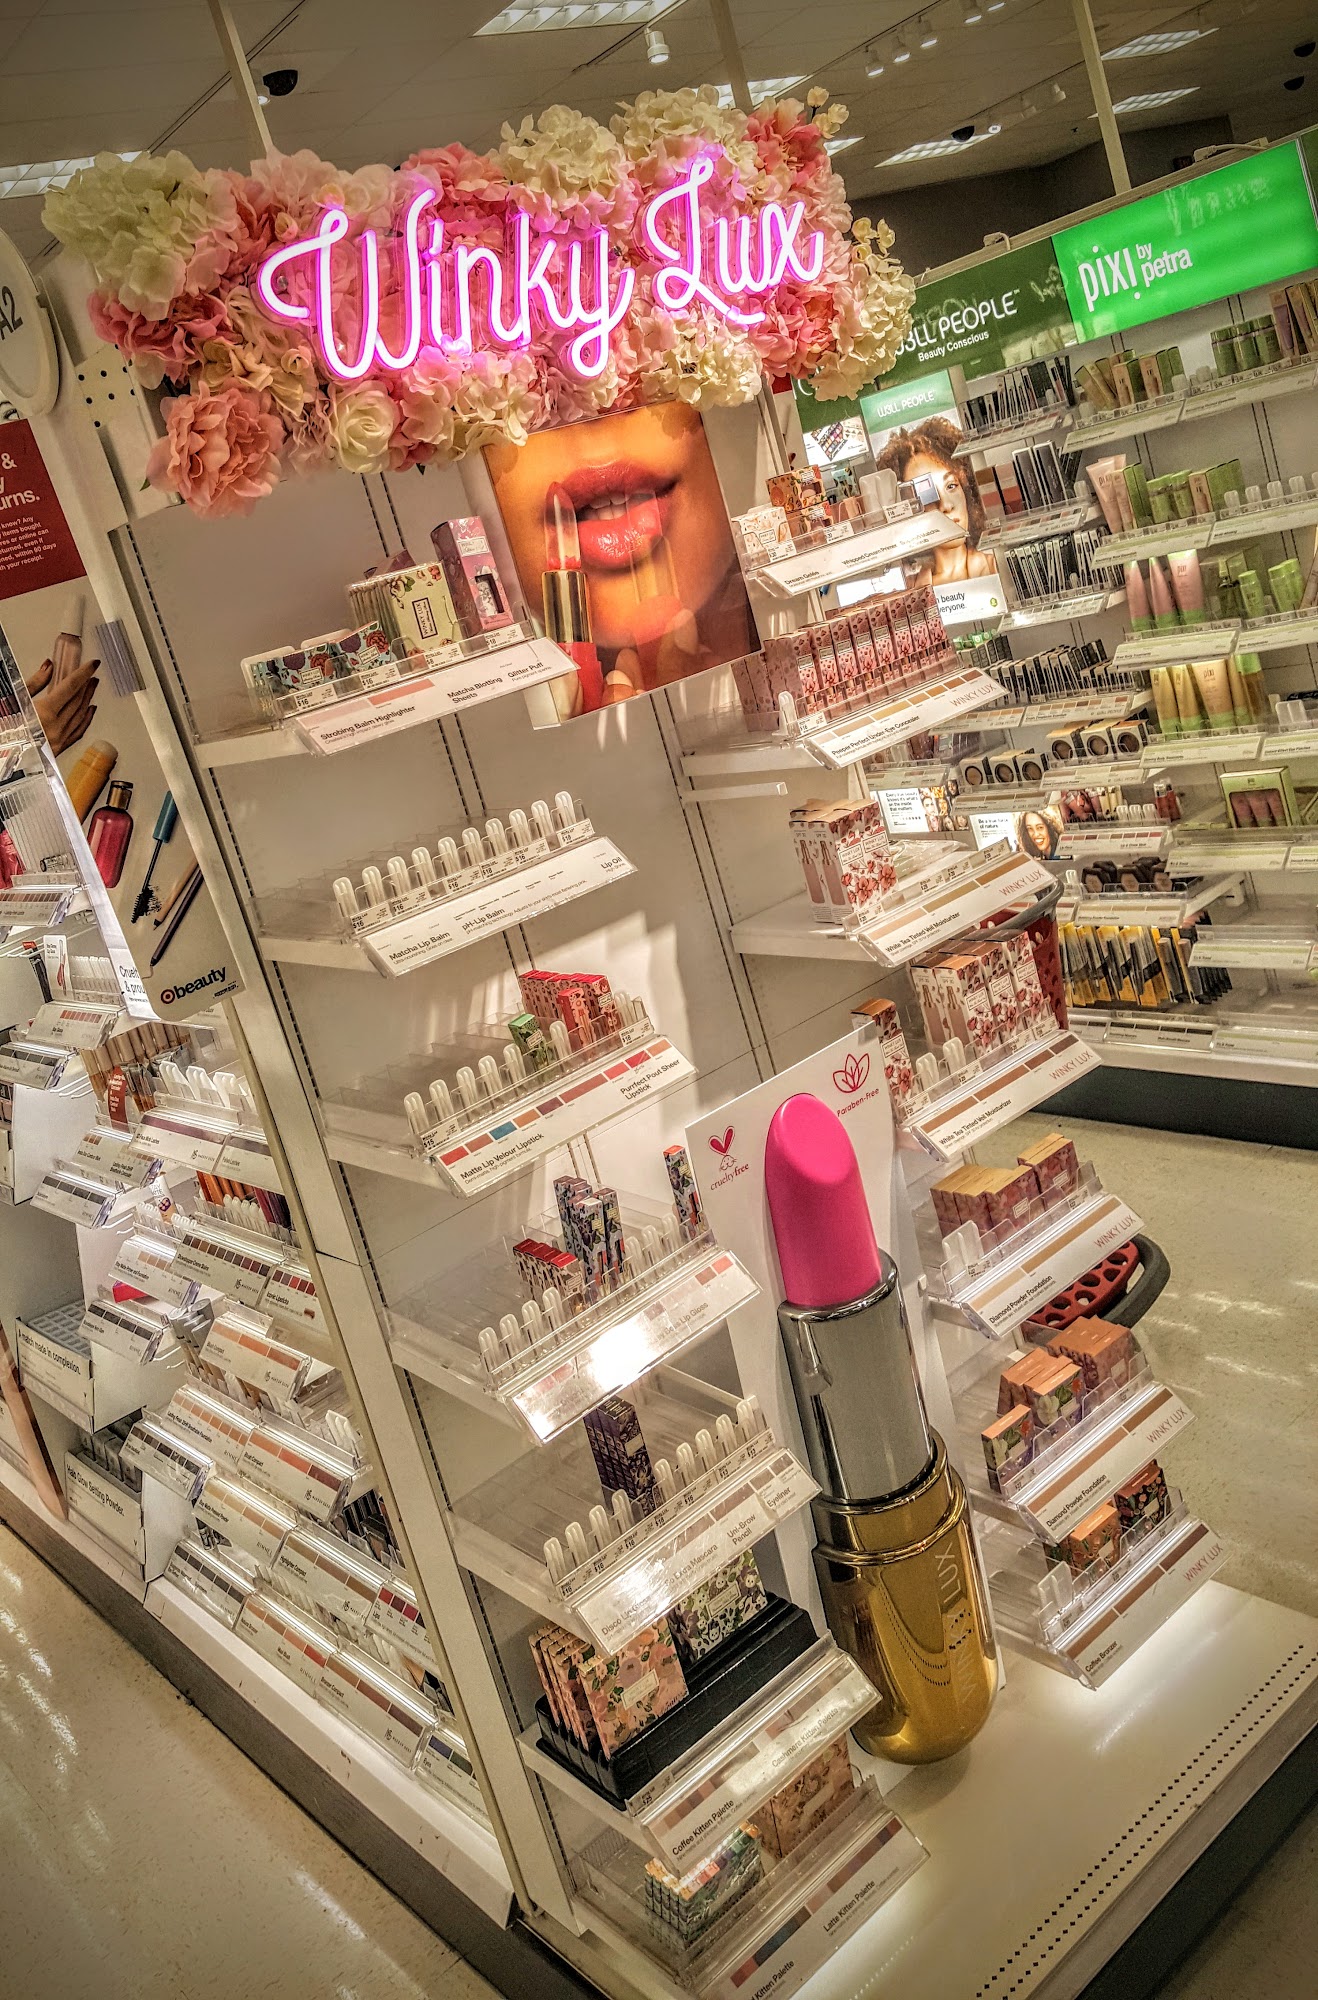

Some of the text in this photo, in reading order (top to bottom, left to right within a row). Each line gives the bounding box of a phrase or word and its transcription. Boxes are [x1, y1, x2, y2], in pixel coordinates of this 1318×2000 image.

[1136, 243, 1152, 260] by
[258, 157, 824, 378] Winky Lux
[1141, 249, 1193, 288] petra
[918, 331, 990, 362] Beauty Conscious
[1, 452, 17, 470] &
[2, 516, 34, 529] know? Any
[2, 522, 42, 538] items bought
[18, 532, 37, 541] online
[24, 540, 38, 548] even
[880, 543, 897, 553] Primer
[7, 555, 44, 570] your receipt.
[15, 549, 33, 558] within
[42, 543, 57, 552] days
[784, 575, 803, 585] Dream
[940, 592, 965, 603] beauty
[508, 667, 529, 678] Glitter
[529, 662, 544, 671] Puff
[447, 677, 503, 699] Matcha Blotting
[452, 692, 478, 704] Sheets
[950, 683, 997, 707] WINKY LUX
[320, 725, 356, 741] Strobing
[354, 718, 375, 730] Balm
[374, 706, 416, 723] Highlighter
[850, 736, 870, 747] Perfect
[869, 726, 895, 739] Under-Eye
[894, 716, 920, 729] Concealer
[600, 856, 623, 870] Lip Oil
[999, 870, 1046, 897] WINKY LUX
[532, 899, 542, 907] your
[461, 908, 506, 931] pH-Lip Balm
[886, 911, 961, 953] White Tea Tinted Veil Moisturizer
[389, 932, 451, 961] Matcha Lip Balm
[174, 967, 226, 999] beauty
[620, 1059, 680, 1094] Purrfect Pout Sheer
[1049, 1050, 1093, 1081] WINKY LUX
[625, 1084, 652, 1100] Lipstick
[836, 1088, 880, 1117] Paraben-free
[939, 1099, 1012, 1145] White Tea Tinted Veil Moisturizer
[460, 1133, 544, 1180] Matte Lip Velour Lipstick
[1094, 1214, 1136, 1248] WINKY LUX
[989, 1304, 1012, 1324] Diamond
[1010, 1290, 1028, 1309] Powder
[1026, 1275, 1053, 1295] Foundation
[680, 1302, 709, 1323] Lip Gloss
[21, 1333, 34, 1347] match
[34, 1341, 47, 1356] made
[47, 1348, 52, 1359] in
[52, 1352, 81, 1376] complexion.
[1146, 1407, 1188, 1444] WINKY LUX
[76, 1472, 89, 1488] Glow
[88, 1480, 106, 1504] Setting
[105, 1492, 125, 1517] Powder.
[766, 1486, 791, 1508] Eyeliner
[1046, 1473, 1108, 1528] Diamond Powder Foundation
[726, 1514, 756, 1538] Uni-Brow
[732, 1528, 753, 1546] Pencil
[689, 1543, 719, 1566] Mascara
[1183, 1543, 1224, 1582] WINKY LUX
[601, 1618, 622, 1636] Disco
[1085, 1641, 1118, 1673] Coffee Bronzer
[800, 1726, 819, 1745] Kitten
[817, 1707, 839, 1729] Palette
[423, 1757, 432, 1769] Eyes
[672, 1799, 734, 1856] Coffee Kitten Palette
[823, 1880, 876, 1933] Latte Kitten Palette
[754, 1960, 795, 2000] Kitten Palette
